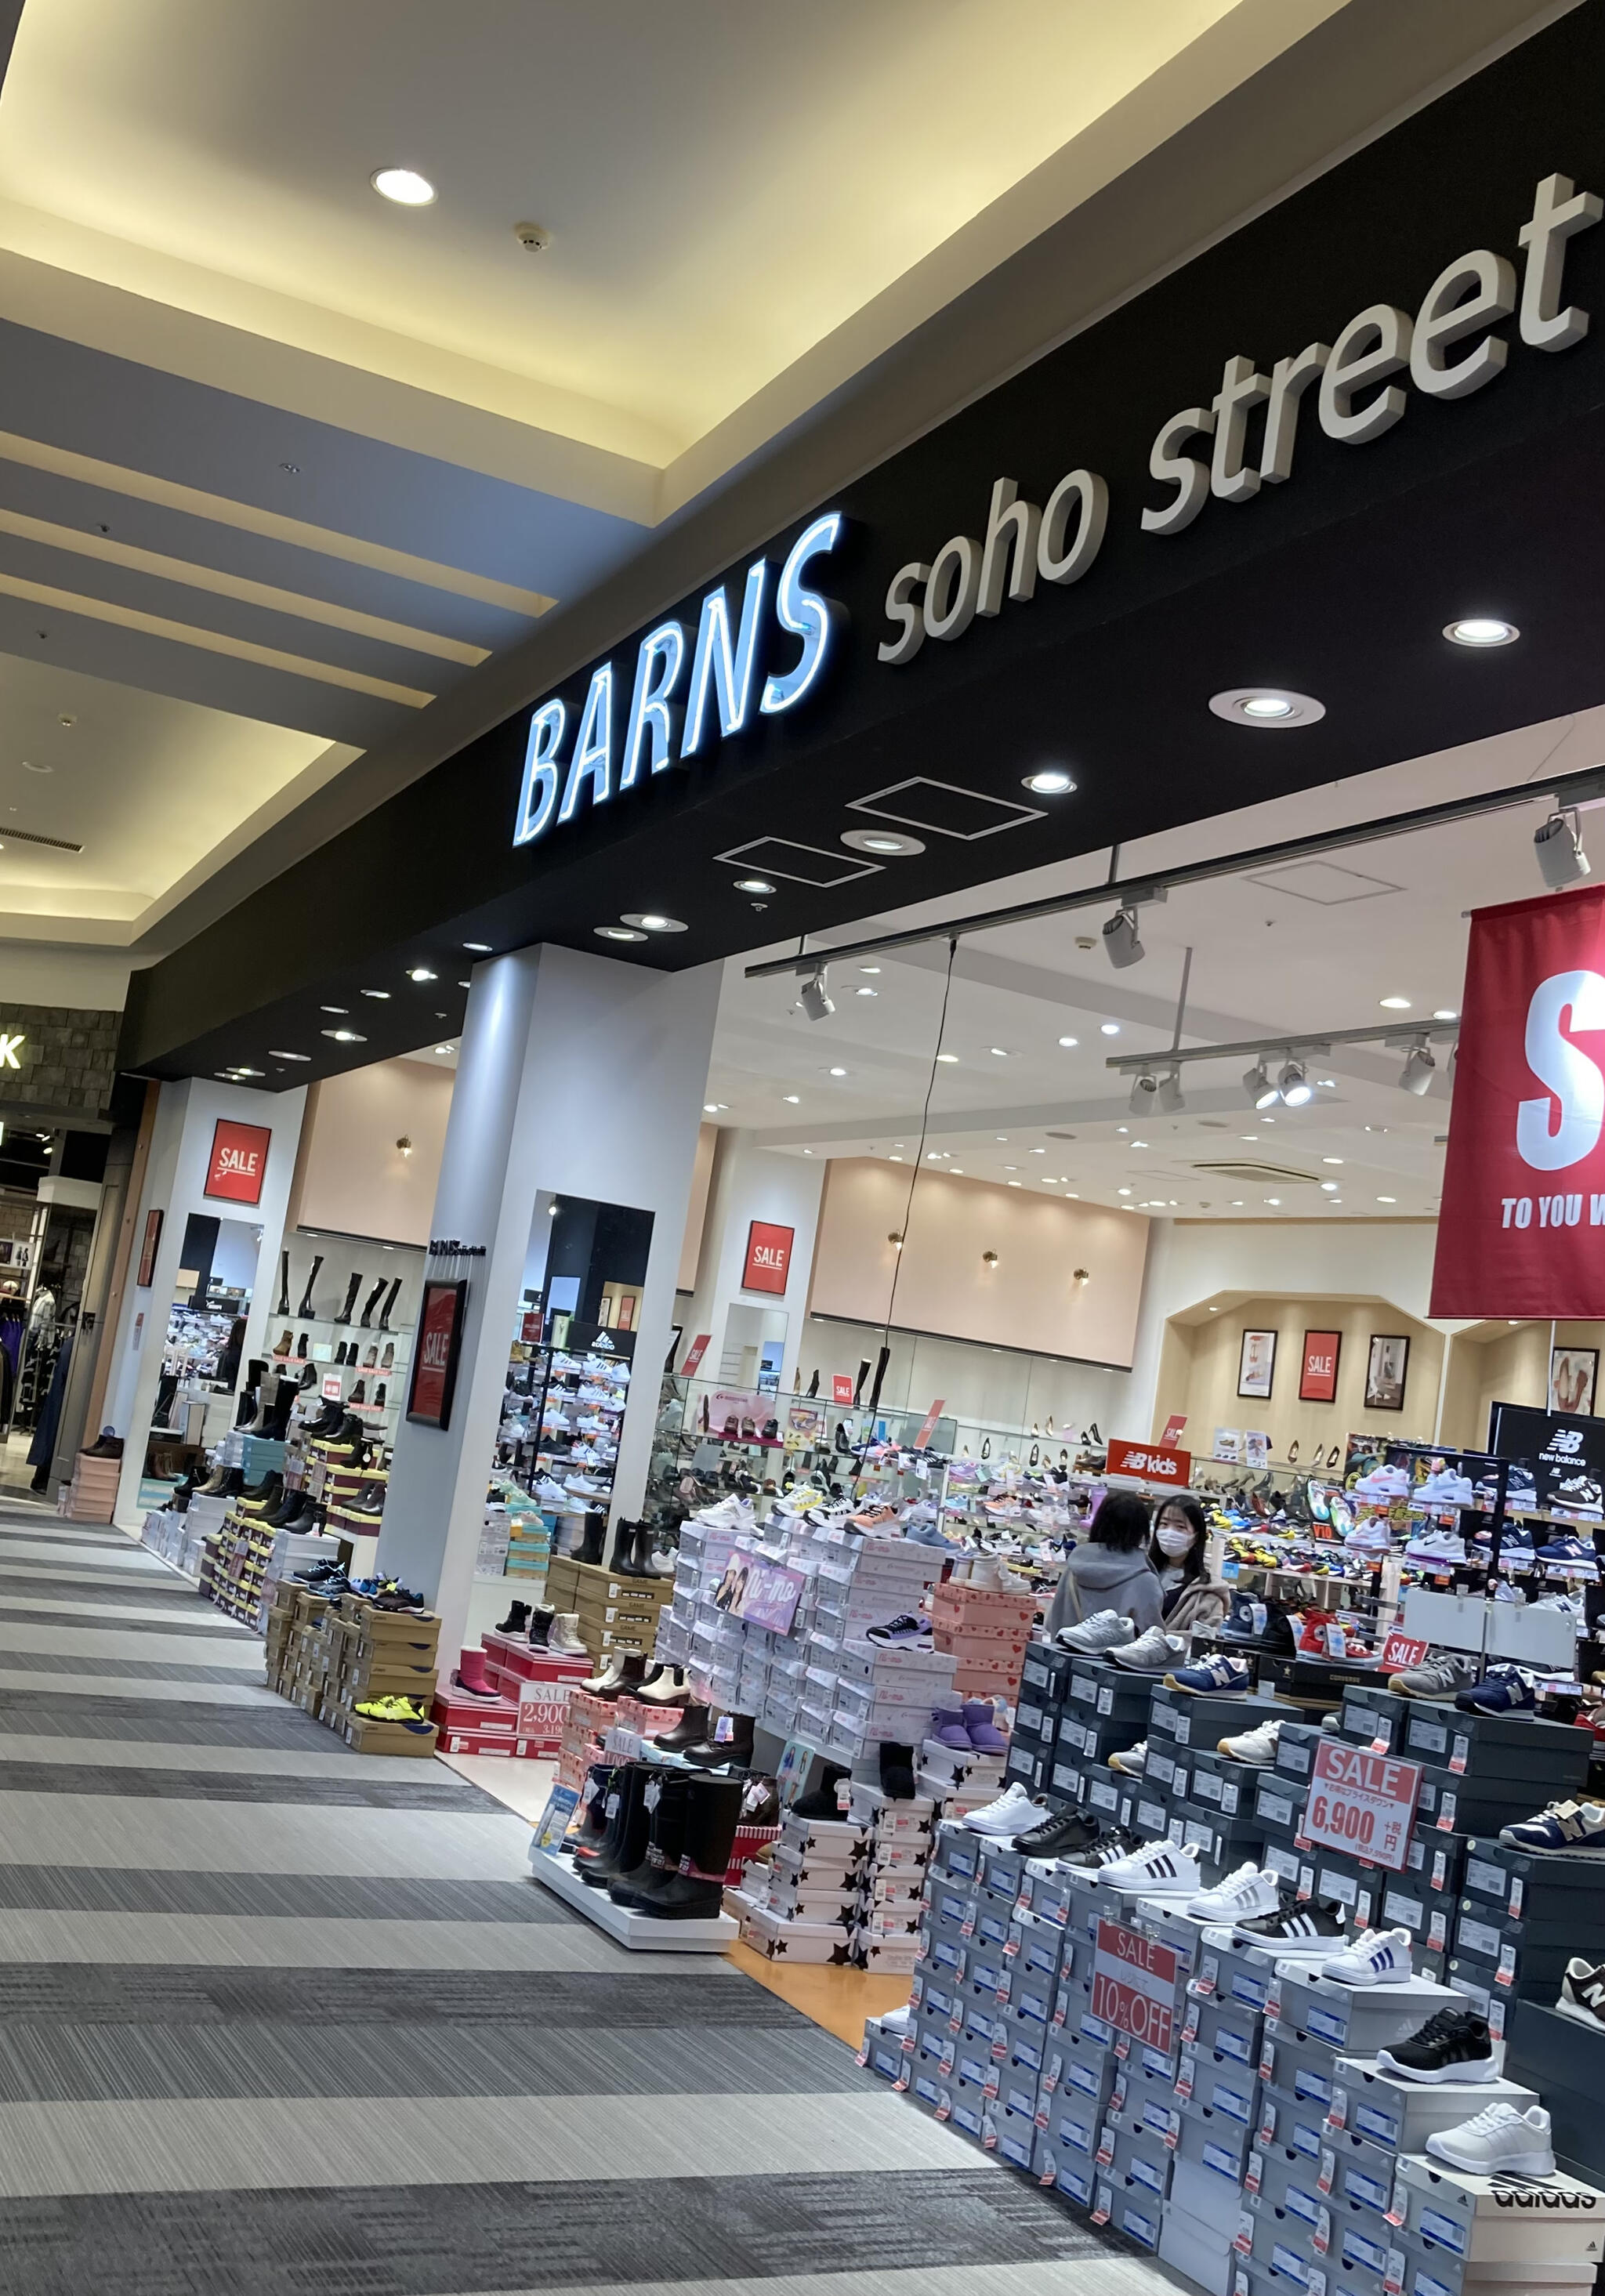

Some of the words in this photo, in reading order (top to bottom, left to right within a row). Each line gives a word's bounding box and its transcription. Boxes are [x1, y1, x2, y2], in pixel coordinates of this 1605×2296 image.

[513, 510, 842, 849] BARNS
[878, 470, 1108, 665] soho
[1141, 172, 1604, 534] street
[219, 1147, 258, 1172] SALE
[1502, 1197, 1532, 1229] TO
[1538, 1194, 1583, 1228] YOU
[754, 1245, 784, 1267] SALE
[423, 1332, 449, 1366] SALE
[689, 1349, 703, 1361] SALE
[1308, 1355, 1331, 1373] SALE
[836, 1385, 850, 1395] SALE
[1147, 1455, 1177, 1475] kids
[1538, 1453, 1555, 1461] new
[1556, 1454, 1586, 1466] balance
[1313, 1524, 1332, 1539] V10
[1388, 1641, 1419, 1664] SALE
[613, 1736, 633, 1754] SALE
[1326, 1749, 1400, 1797] SALE
[1312, 1795, 1375, 1845] 6,900
[1384, 1834, 1397, 1852] 円
[1117, 1932, 1155, 1972] SALE
[1491, 2190, 1596, 2209] adidas
